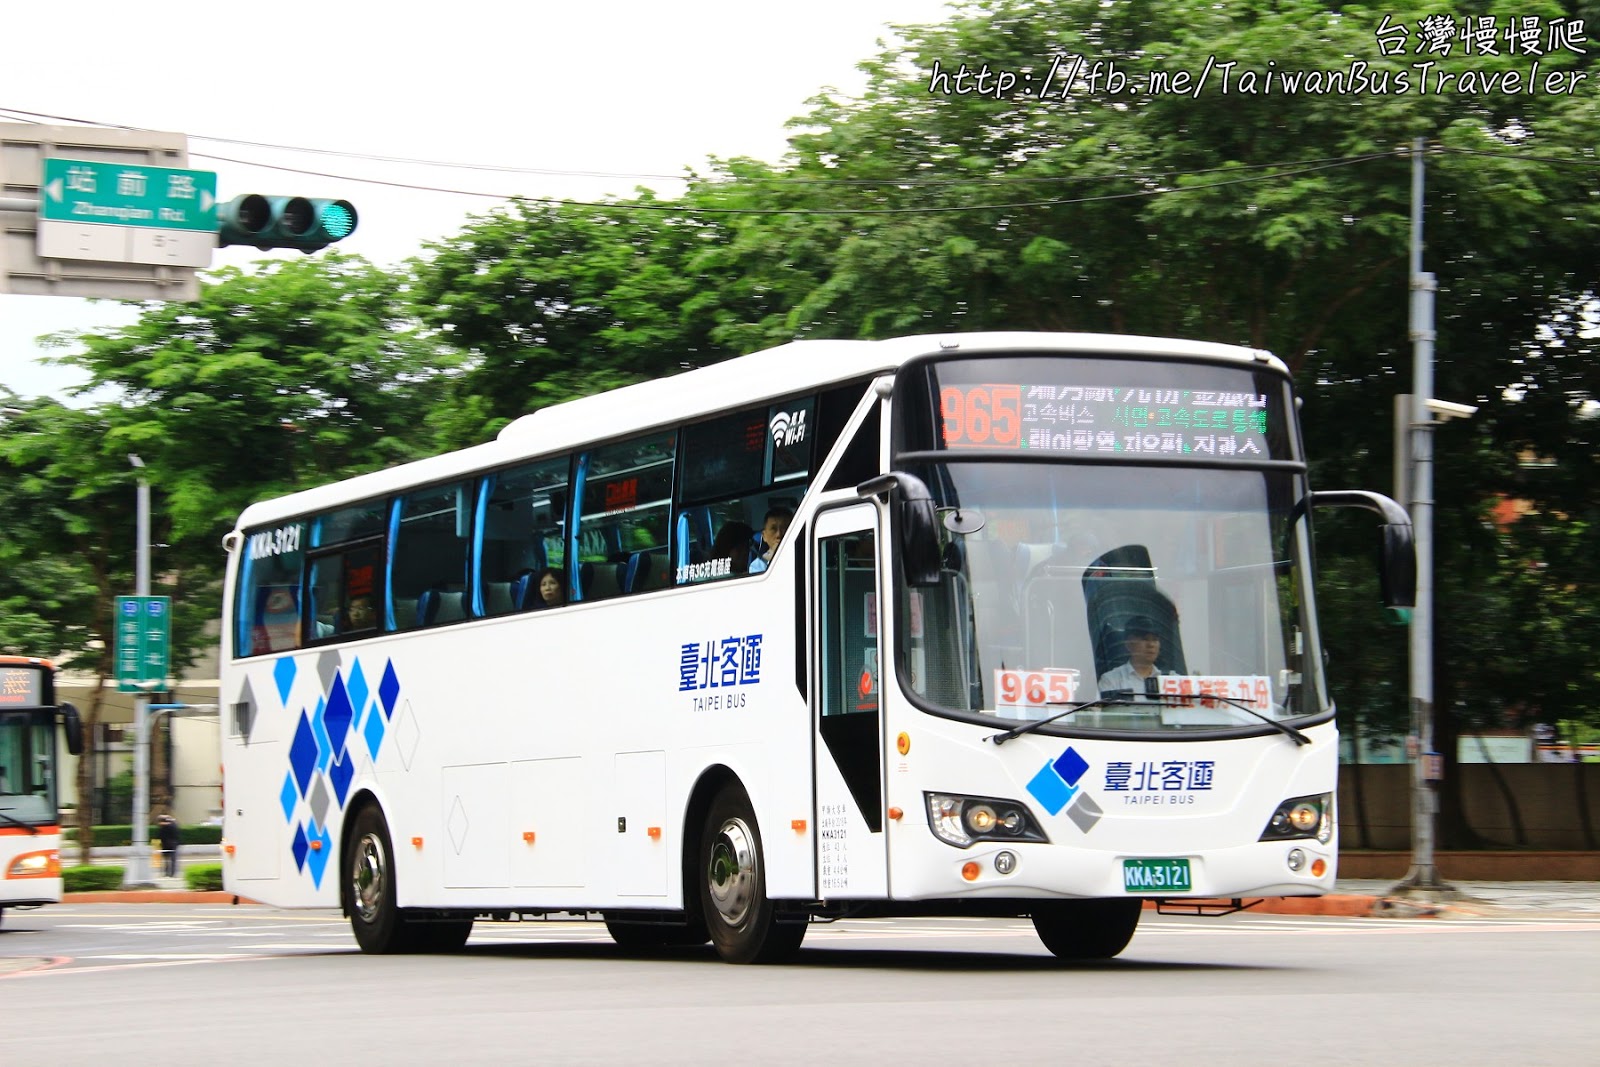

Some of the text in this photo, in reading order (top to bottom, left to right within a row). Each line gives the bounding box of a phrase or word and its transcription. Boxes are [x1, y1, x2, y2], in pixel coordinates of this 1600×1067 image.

[941, 386, 1018, 443] 965
[679, 634, 763, 691] 臺北客運
[693, 692, 746, 712] TAIPEI BUS
[1001, 672, 1070, 704] 965
[1103, 760, 1216, 792] 臺北客運
[1124, 794, 1195, 805] TAIPEI BUS
[822, 829, 847, 839] KKA3121
